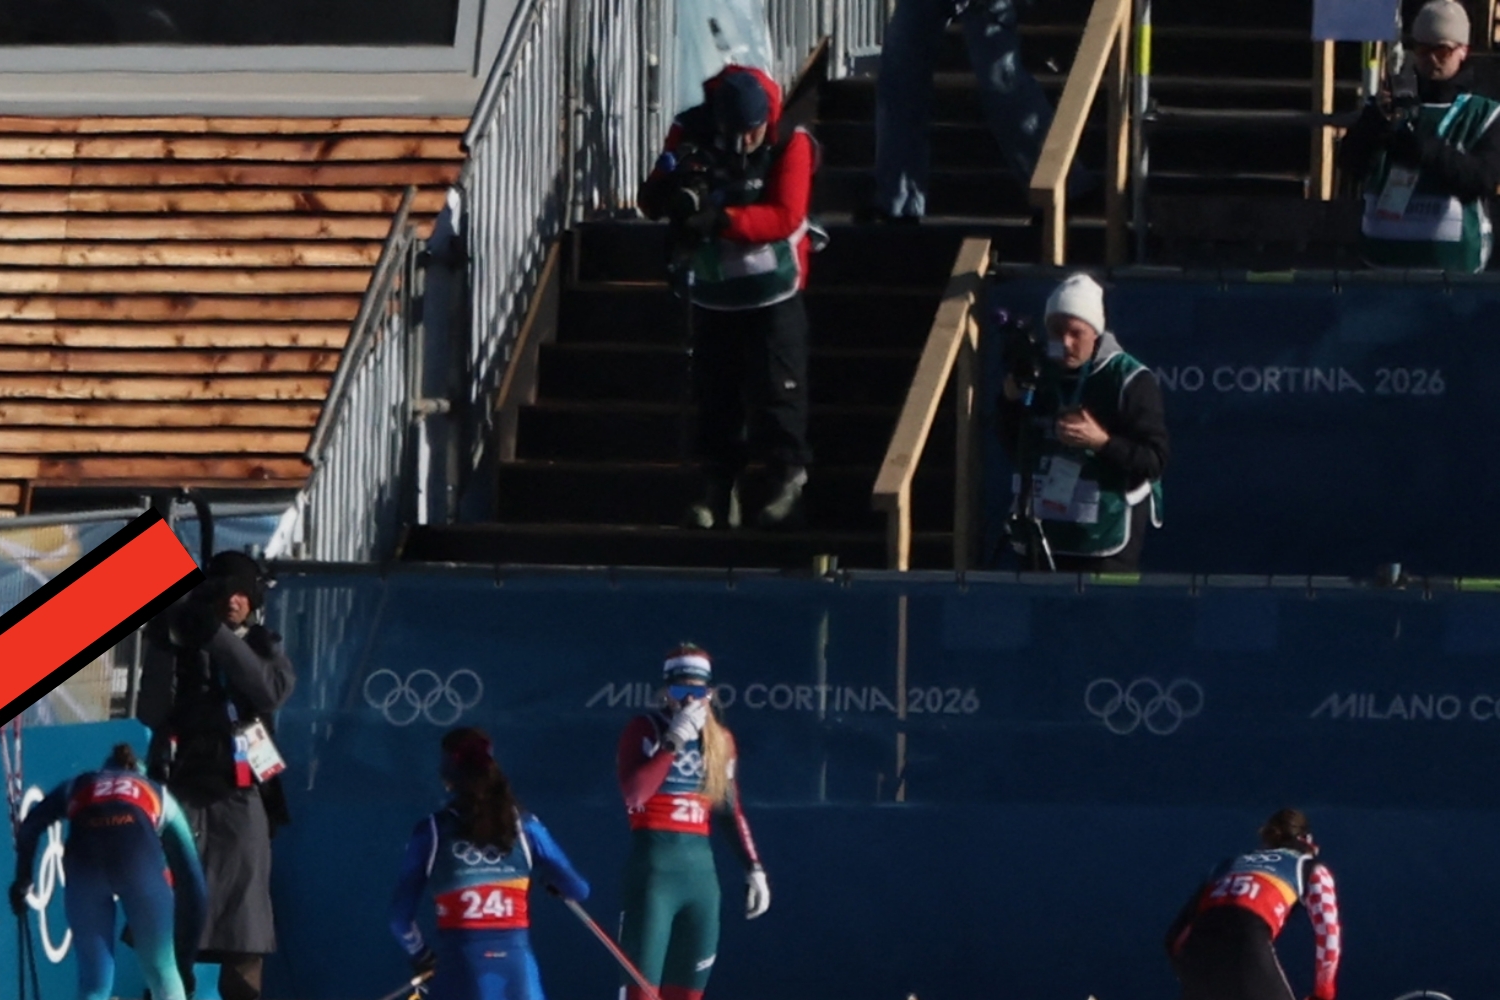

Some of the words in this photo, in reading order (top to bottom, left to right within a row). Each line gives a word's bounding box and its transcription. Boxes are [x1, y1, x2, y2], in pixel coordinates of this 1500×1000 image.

[1212, 365, 1366, 394] CORTINA
[1374, 367, 1446, 395] 2026
[585, 682, 737, 709] MILO
[744, 683, 899, 712] CORTINA
[908, 686, 981, 714] 2026
[1308, 692, 1461, 720] MILANO
[1470, 694, 1500, 721] C
